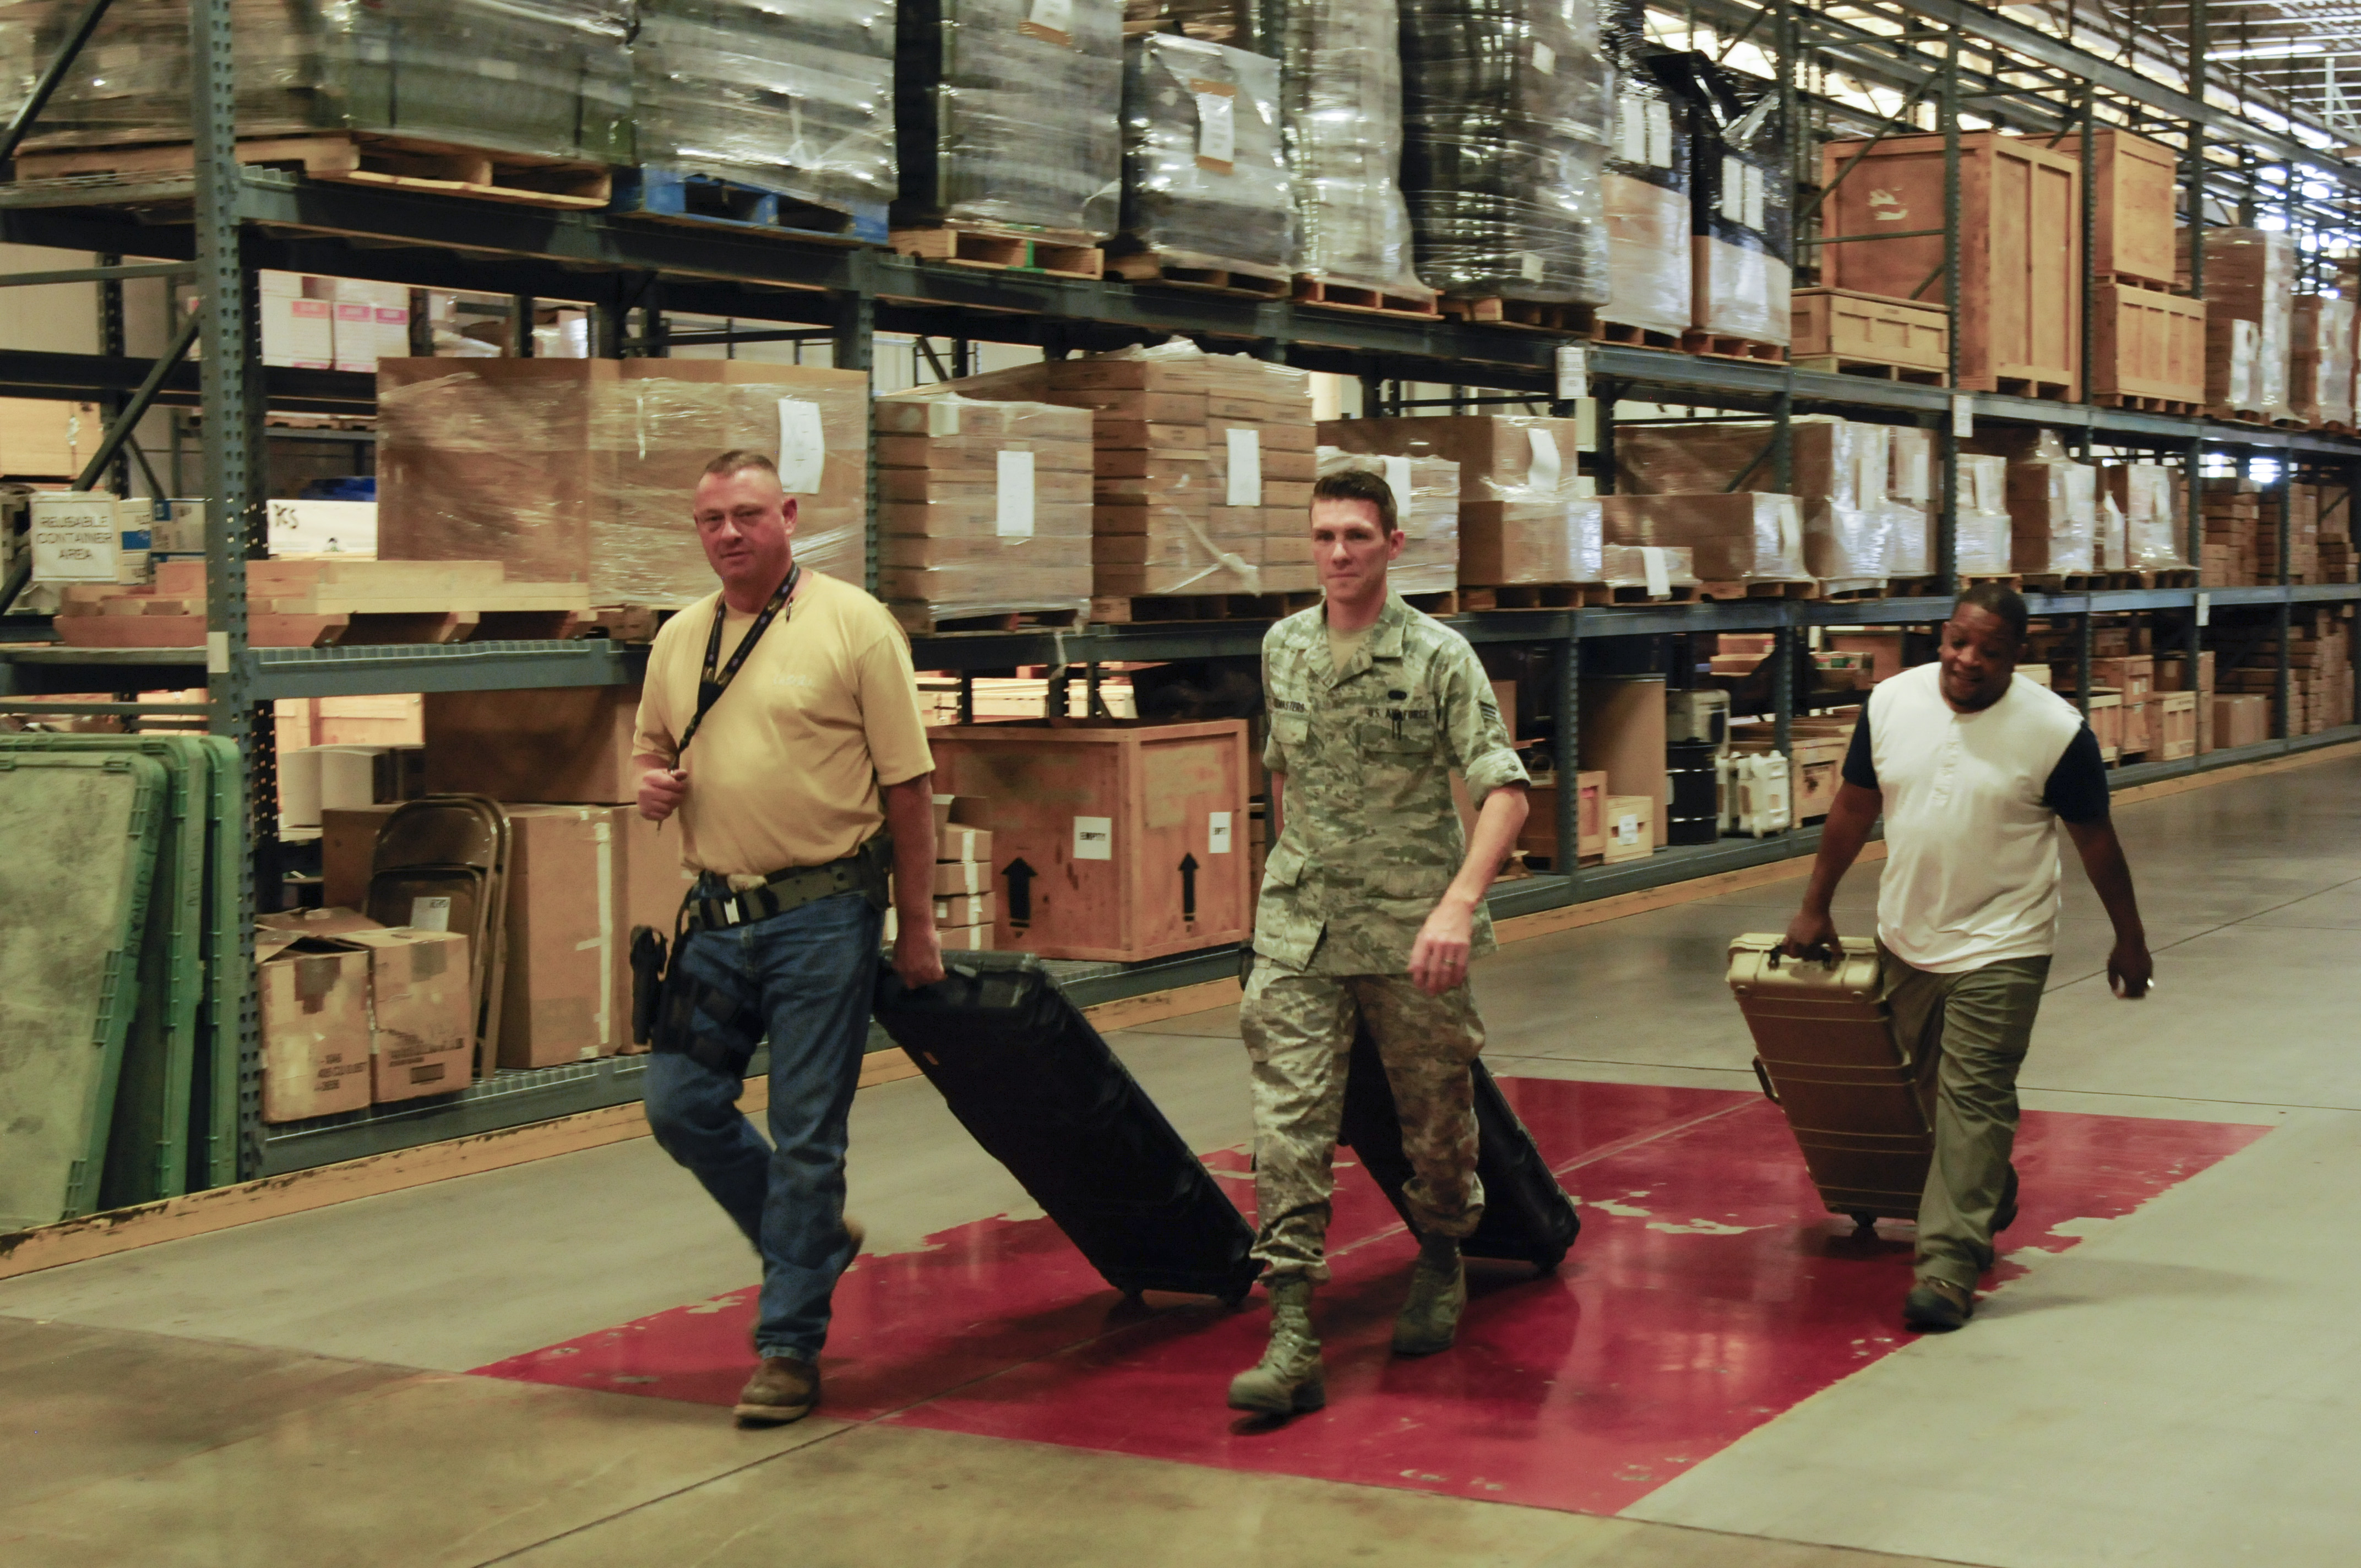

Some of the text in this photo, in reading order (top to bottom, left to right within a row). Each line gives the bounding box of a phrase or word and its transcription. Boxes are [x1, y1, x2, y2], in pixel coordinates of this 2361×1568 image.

[40, 516, 109, 527] REUSABLE
[36, 532, 113, 543] CONTAINER
[58, 548, 94, 559] AREA
